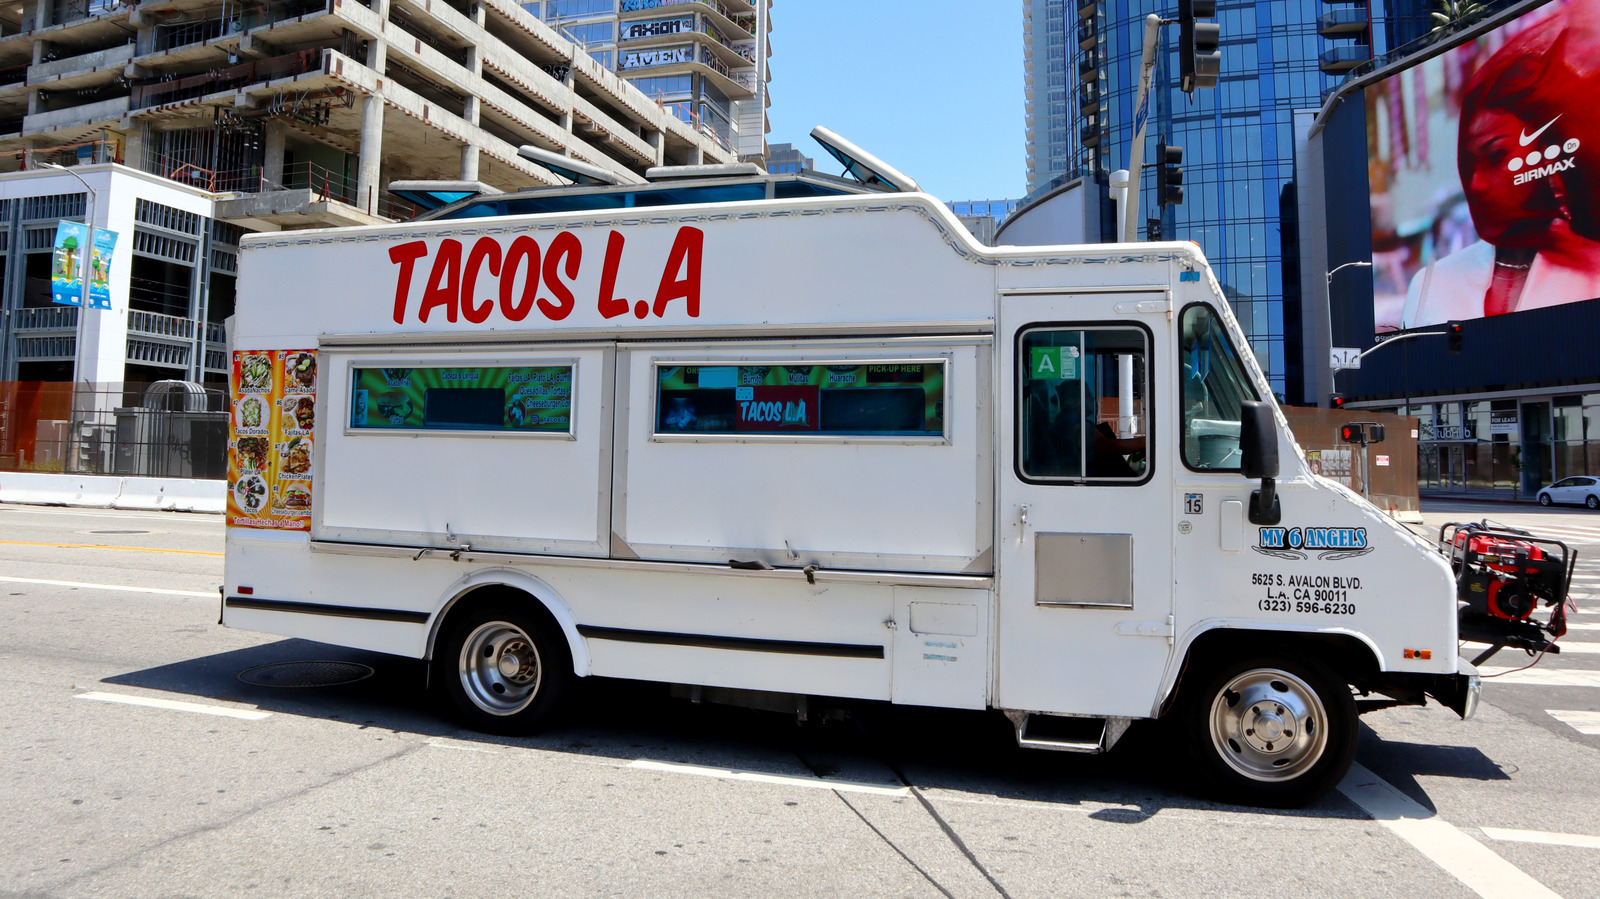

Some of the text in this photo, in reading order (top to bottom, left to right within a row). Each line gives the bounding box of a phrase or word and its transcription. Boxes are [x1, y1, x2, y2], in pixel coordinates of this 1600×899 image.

[388, 226, 704, 324] TACOS L.A
[869, 365, 899, 373] PICK-UP
[1037, 354, 1055, 372] A
[463, 372, 479, 381] Lengua
[508, 372, 523, 384] Fajitas
[533, 372, 546, 381] Plato
[789, 372, 809, 383] Mulitas
[829, 373, 856, 382] Huarache
[526, 398, 560, 410] Cheeseburger
[740, 401, 806, 423] TACOS L.A
[1186, 499, 1201, 512] 15
[271, 508, 297, 516] Cheeseburger
[233, 517, 255, 525] Tortillas
[1260, 528, 1367, 549] MY 6 ANGELS
[1252, 573, 1363, 589] 5625 S. AVALON BLVD.
[1267, 587, 1347, 602] L.A. CA 90011
[1258, 599, 1356, 615] (323) 596-6230
